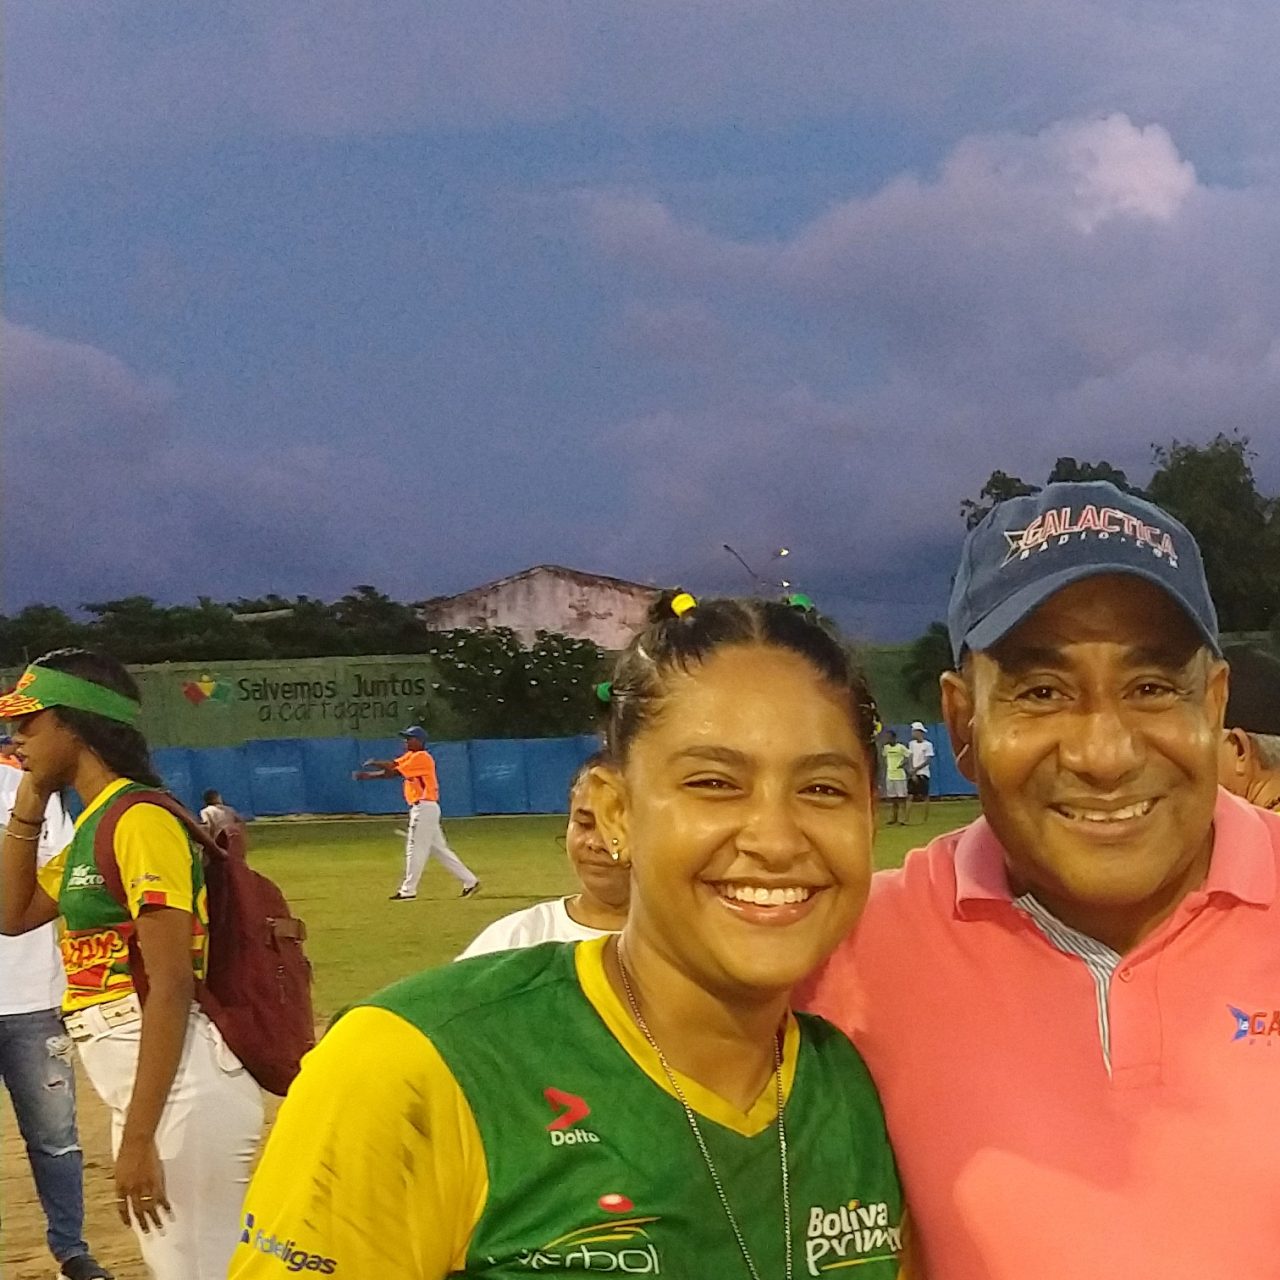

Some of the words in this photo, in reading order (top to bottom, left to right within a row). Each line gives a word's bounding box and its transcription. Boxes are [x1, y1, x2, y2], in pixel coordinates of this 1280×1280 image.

[1020, 503, 1179, 560] GALACTICA
[237, 677, 337, 701] Salvemos
[352, 673, 426, 699] Juntos
